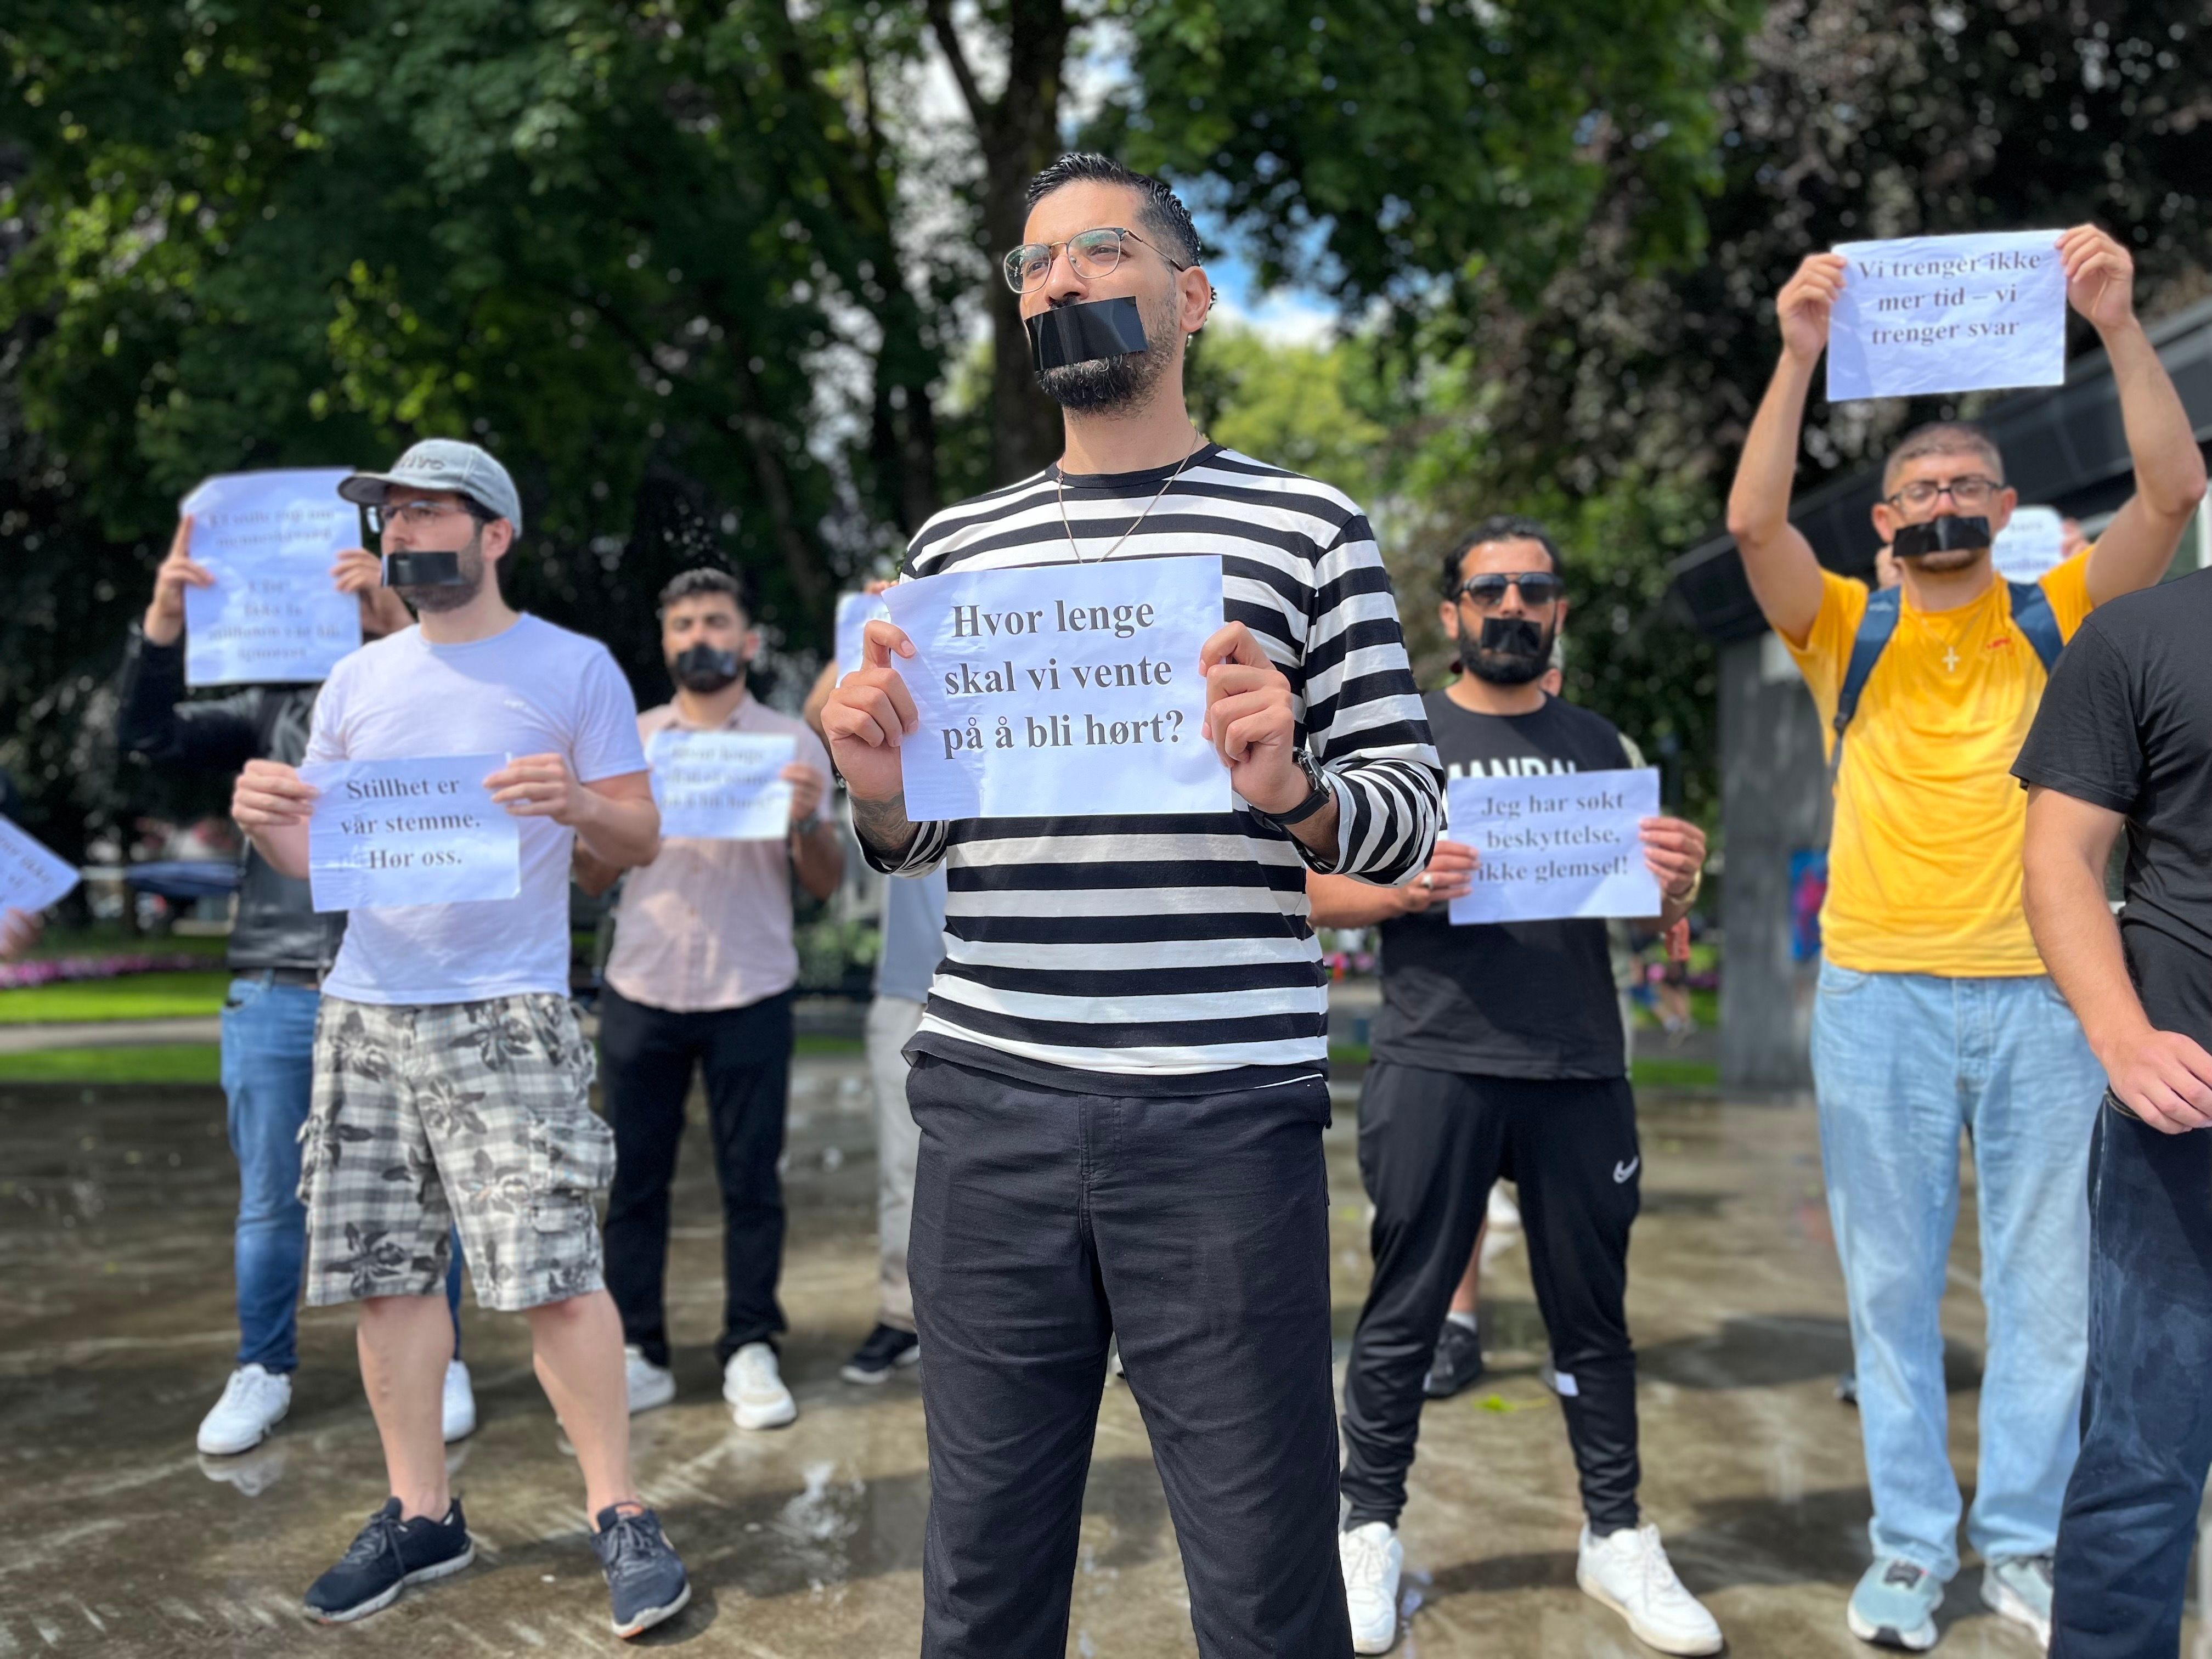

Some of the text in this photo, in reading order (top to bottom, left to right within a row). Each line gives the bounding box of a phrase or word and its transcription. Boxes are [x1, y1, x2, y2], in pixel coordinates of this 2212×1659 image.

[1858, 251, 2041, 280] Vi trenger ikke
[1877, 294, 1926, 312] mer
[1933, 286, 1965, 307] tid
[1995, 284, 2017, 302] vi
[1872, 321, 2019, 346] trenger svar
[951, 600, 1154, 639] Hvor lenge
[945, 655, 1173, 696] skal vi vente
[941, 709, 1184, 760] på å bli hørt?
[346, 778, 460, 799] Stillhet er
[1481, 797, 1521, 819] Jeg
[1528, 794, 1569, 813] har
[385, 814, 481, 833] stemme.
[421, 851, 462, 867] oss.
[1478, 862, 1527, 882] ikke
